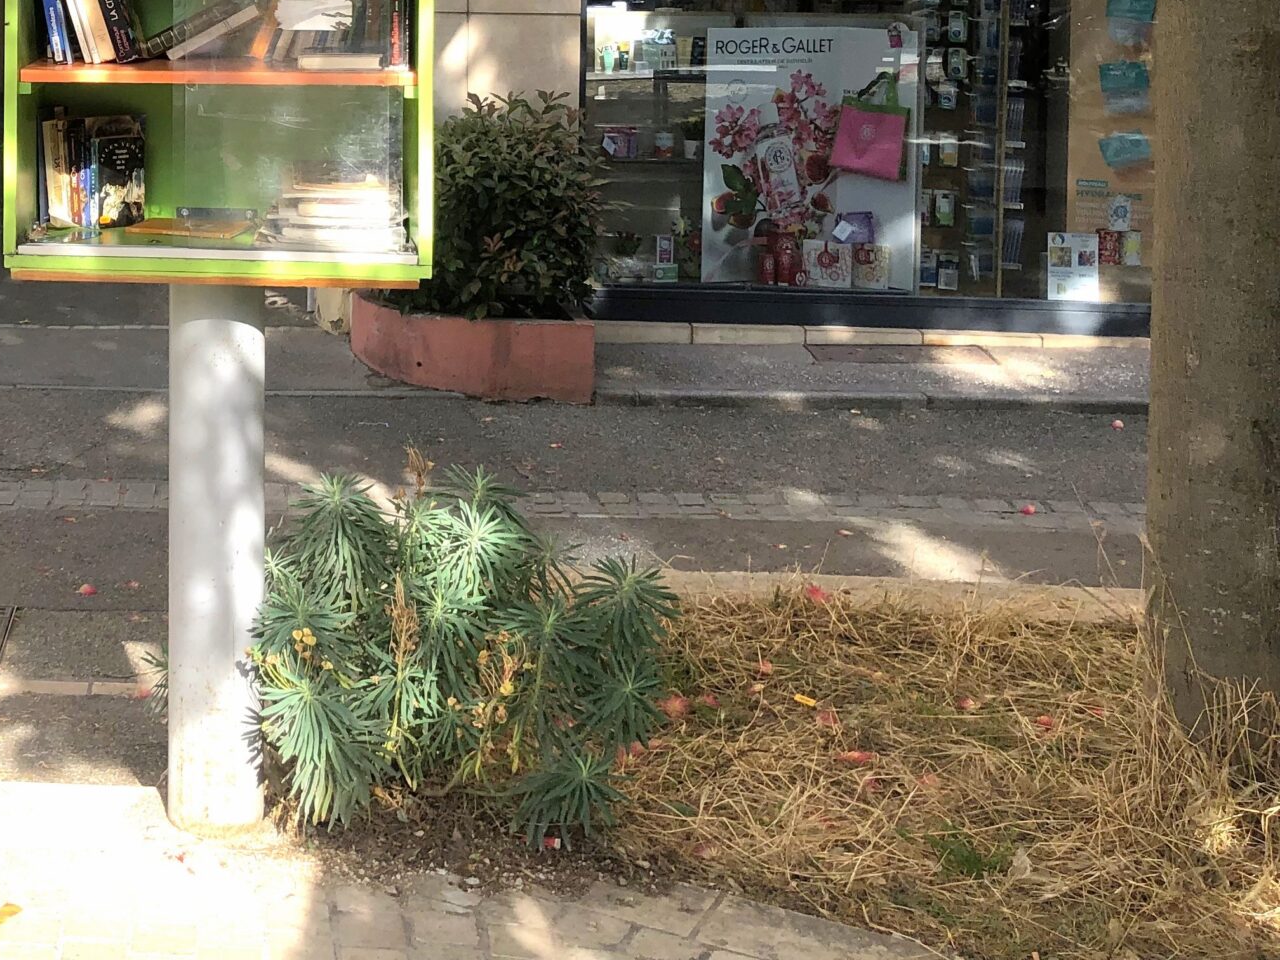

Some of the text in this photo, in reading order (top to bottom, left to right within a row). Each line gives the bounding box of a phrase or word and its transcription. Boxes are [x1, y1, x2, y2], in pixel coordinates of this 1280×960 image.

[108, 9, 119, 21] LA
[715, 36, 835, 55] ROGER & GALLET
